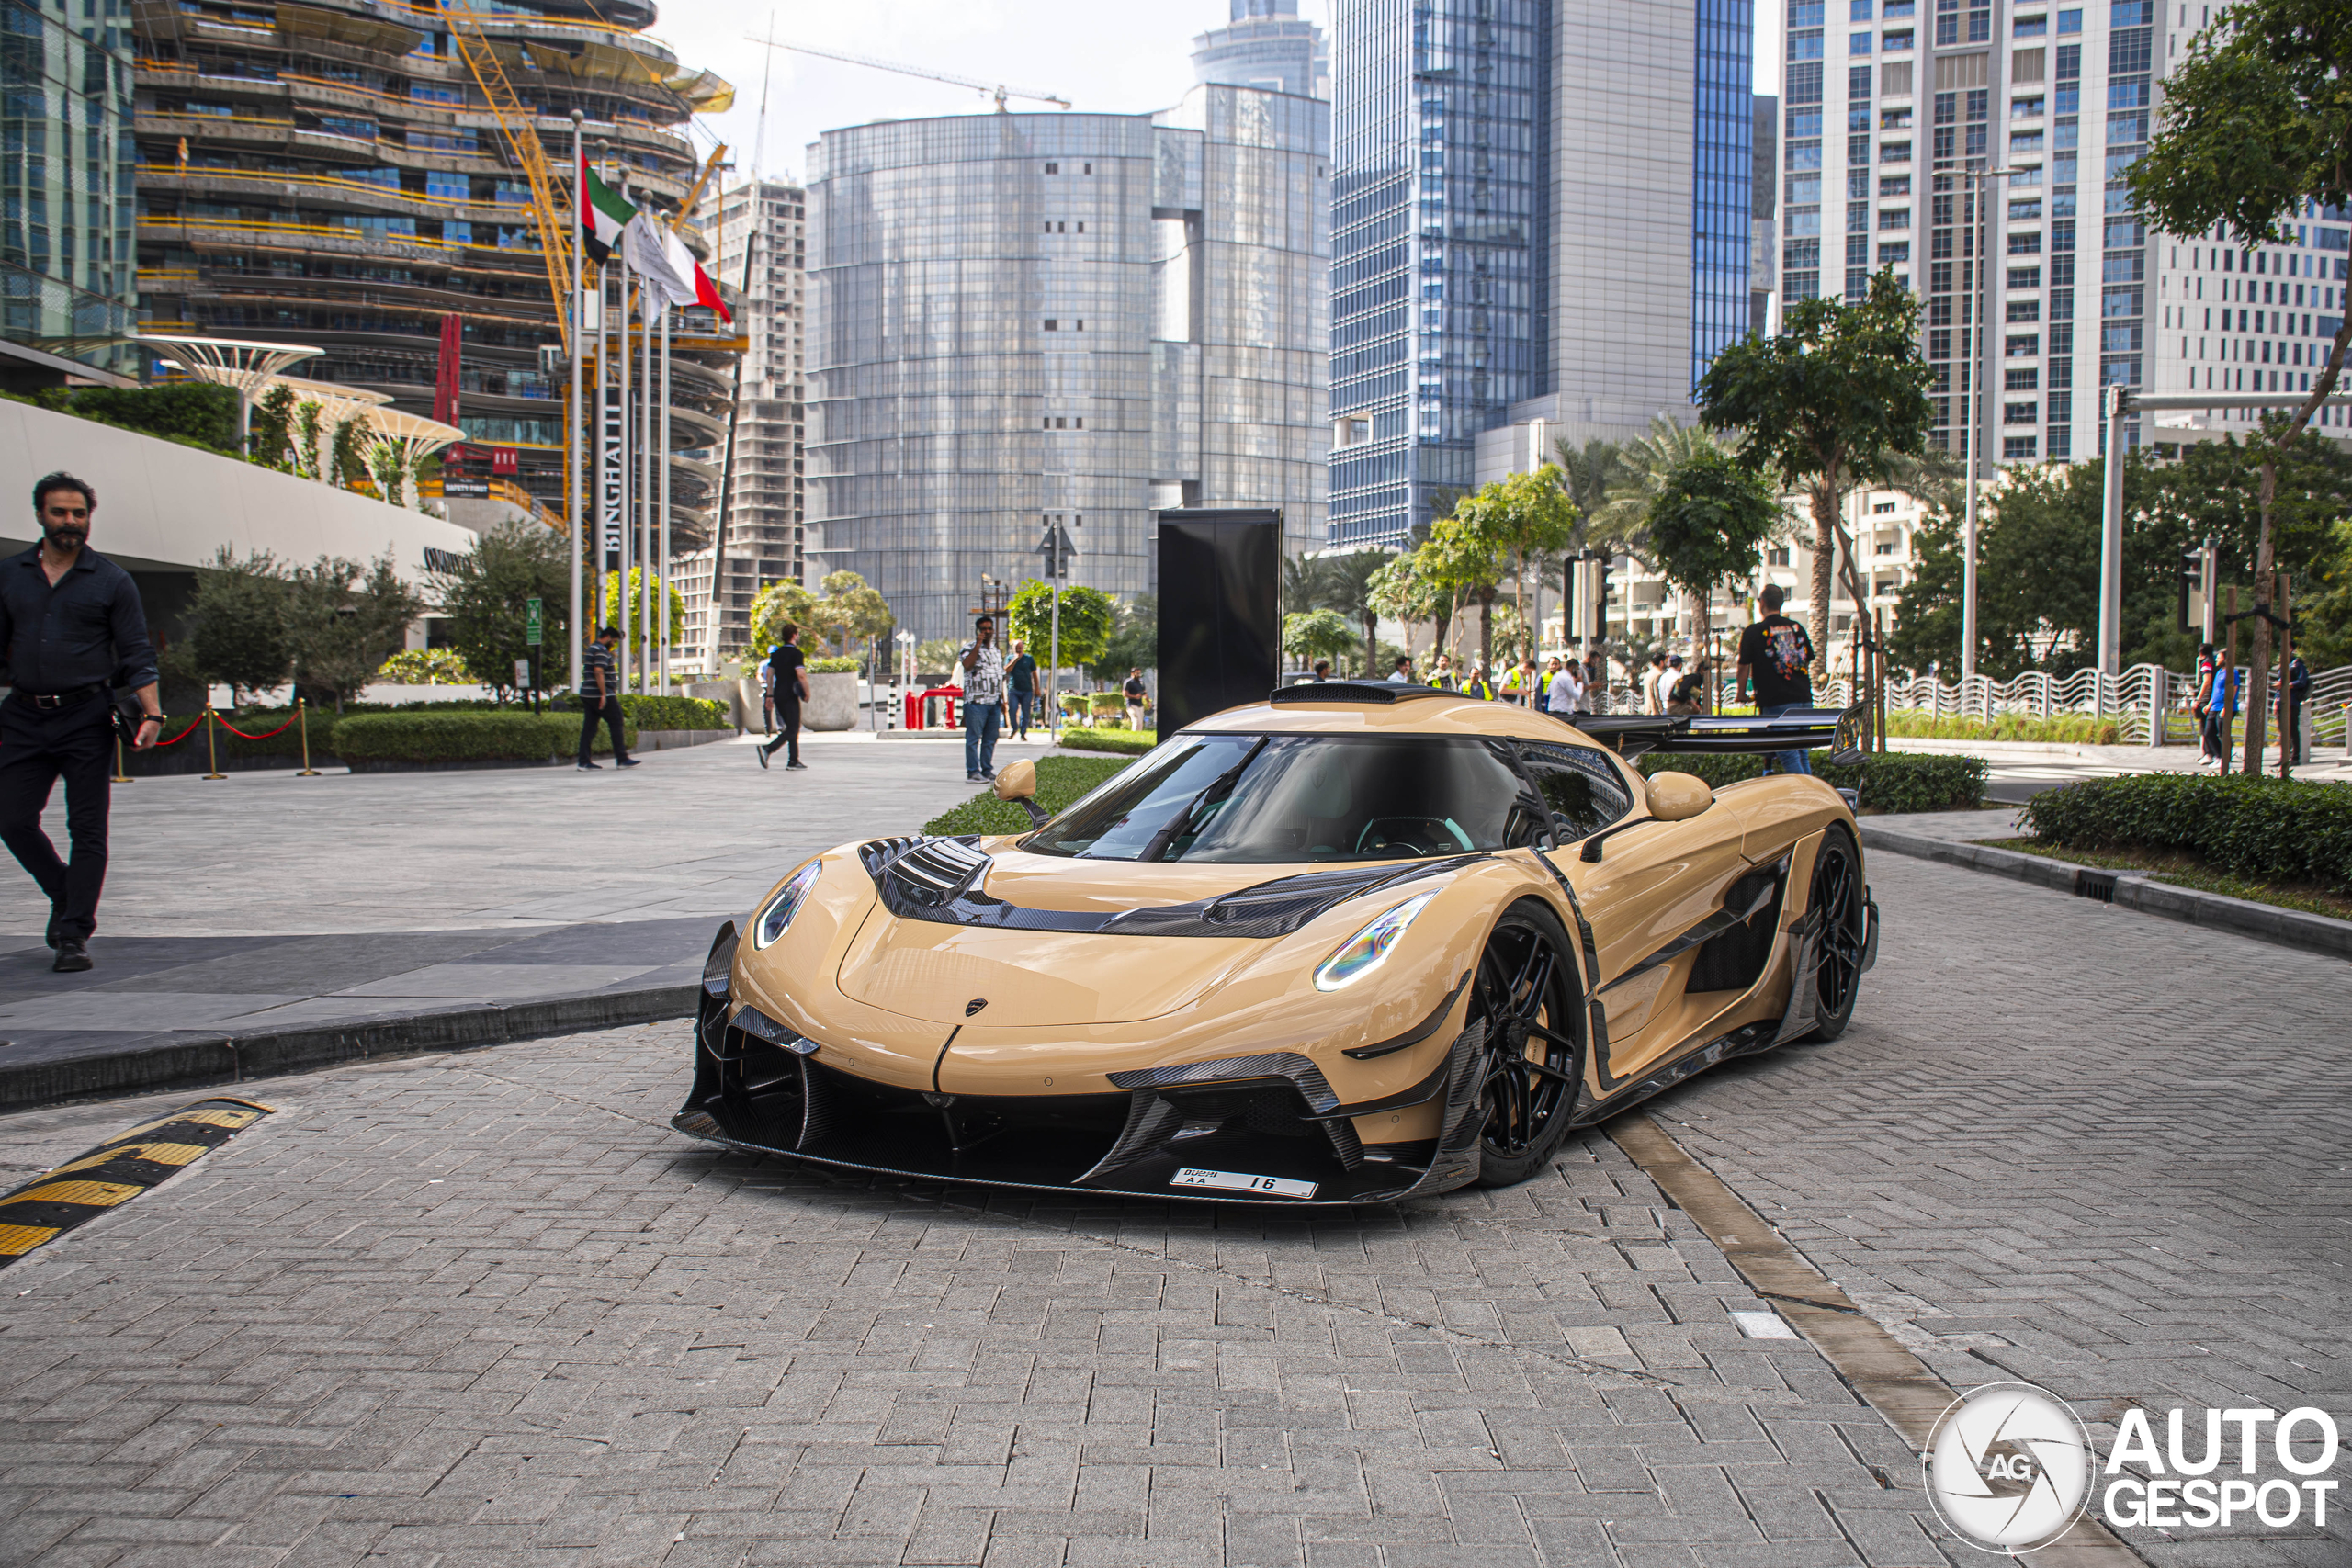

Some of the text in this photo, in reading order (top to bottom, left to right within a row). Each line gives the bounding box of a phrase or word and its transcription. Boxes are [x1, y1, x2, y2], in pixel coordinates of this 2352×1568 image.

[445, 483, 489, 493] SAFETY FIRST
[1250, 1177, 1276, 1190] 16
